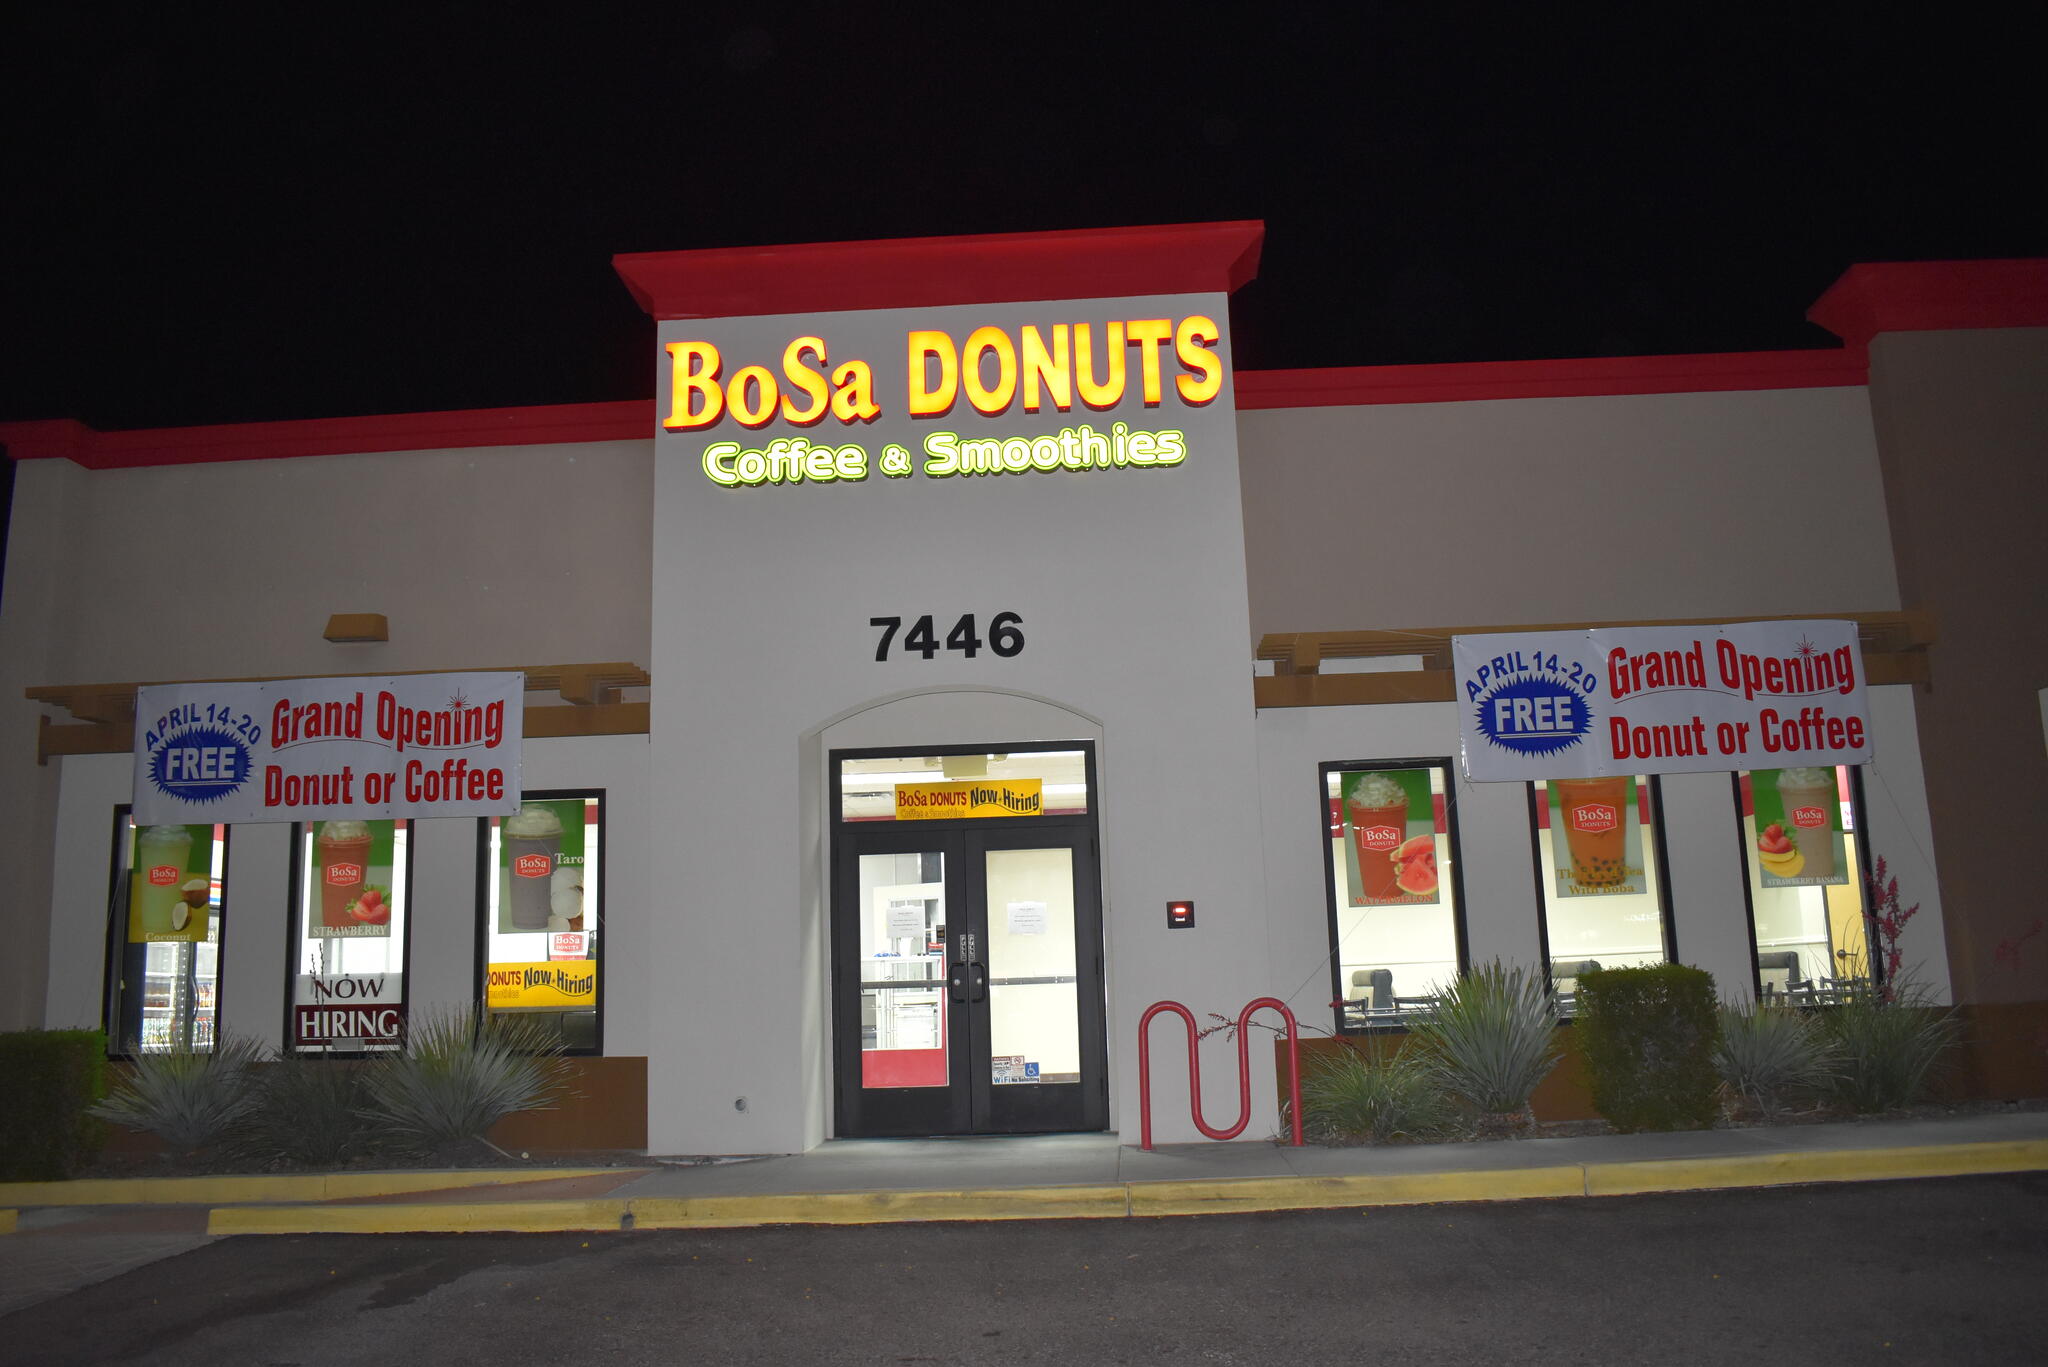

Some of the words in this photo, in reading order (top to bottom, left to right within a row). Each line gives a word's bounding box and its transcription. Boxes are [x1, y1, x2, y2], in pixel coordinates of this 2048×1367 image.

[663, 336, 881, 431] BoSa
[907, 315, 1223, 418] DONUTS
[703, 437, 868, 486] Coffee
[879, 443, 912, 477] &
[923, 421, 1187, 476] Smoothies
[869, 611, 1026, 662] 7446
[1465, 650, 1529, 703] APRIL
[1532, 650, 1597, 694] 14-20
[1607, 640, 1706, 700] Grand
[1715, 638, 1855, 701] Opening
[271, 692, 364, 749] Grand
[376, 690, 504, 752] Opening
[1497, 696, 1573, 733] FREE
[145, 703, 202, 752] APRIL
[205, 703, 262, 746] 14-20
[1609, 715, 1708, 760] Donut
[1716, 721, 1750, 756] or
[1759, 706, 1865, 753] Coffee
[165, 746, 236, 780] FREE
[264, 765, 354, 807] Donut
[364, 771, 395, 806] or
[405, 758, 504, 802] Coffee
[898, 790, 927, 807] BoSa
[930, 791, 967, 806] DONUTS
[970, 787, 998, 809] Now
[1002, 787, 1040, 811] Hiring
[1577, 808, 1611, 821] BoSa
[1796, 809, 1822, 819] BoSa
[1366, 829, 1396, 841] BoSa
[520, 857, 547, 869] BoSa
[554, 852, 585, 865] Taro
[152, 869, 176, 878] BoSa
[330, 866, 357, 878] BoSa
[145, 932, 191, 941] Coconut
[312, 925, 388, 937] STRAWBERRY
[555, 935, 581, 945] BoSa
[314, 978, 385, 1000] NOW
[524, 967, 552, 990] Now
[556, 968, 593, 994] Hiring
[301, 1009, 399, 1038] HIRING
